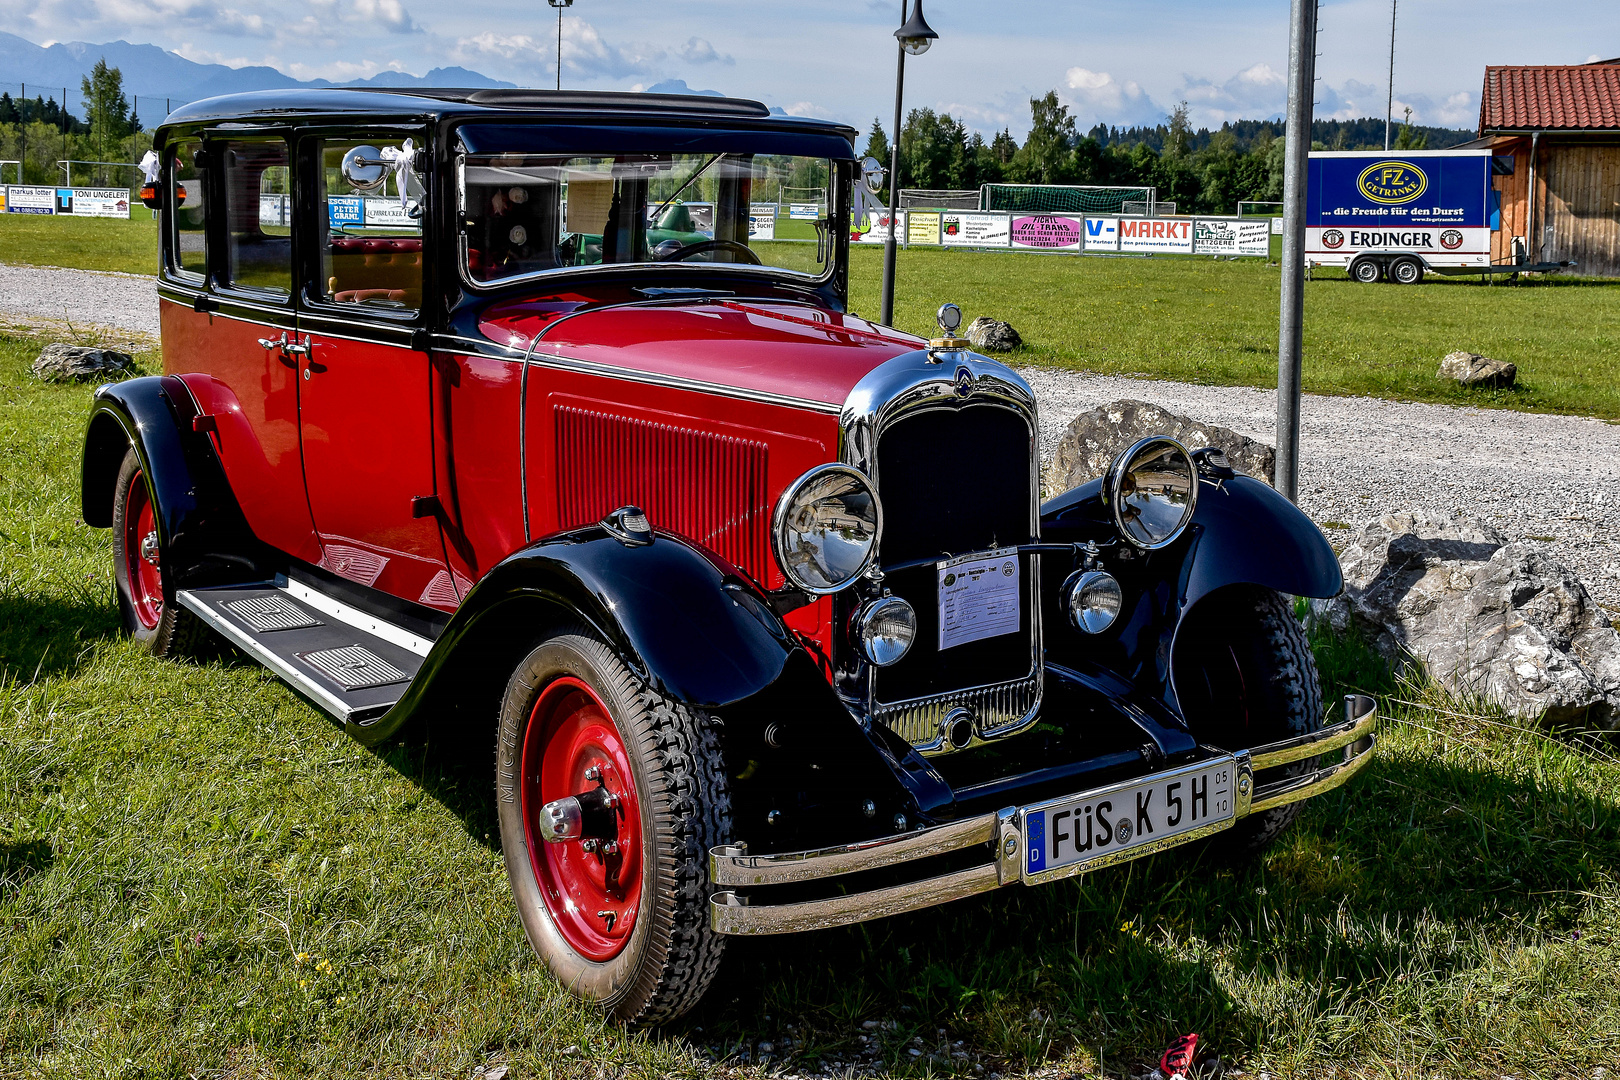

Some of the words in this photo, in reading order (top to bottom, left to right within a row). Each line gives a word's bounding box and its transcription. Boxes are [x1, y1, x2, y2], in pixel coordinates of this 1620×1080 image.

[1381, 168, 1405, 186] FZ
[35, 188, 51, 196] lotter
[74, 190, 91, 198] TONI
[93, 191, 128, 199] UNGELERT
[1365, 181, 1419, 197] GETRÄNKE
[334, 205, 360, 213] PETER
[334, 212, 360, 220] GRAML
[1333, 207, 1350, 216] die
[1351, 207, 1388, 216] Freude
[1390, 207, 1408, 216] für
[1410, 207, 1430, 216] den
[1432, 207, 1464, 216] Durst
[1033, 216, 1058, 224] FICHTL
[1121, 221, 1191, 239] MARKT
[1195, 239, 1235, 247] METZGEREI
[1349, 230, 1433, 248] ERDINGER
[500, 672, 535, 804] MICHELIN
[1215, 770, 1228, 785] 05
[1215, 799, 1228, 814] 10
[1052, 800, 1114, 860] FÜS
[1136, 788, 1154, 837] K
[1166, 781, 1183, 827] 5
[1191, 774, 1208, 821] H
[1031, 848, 1039, 863] D
[1078, 858, 1107, 872] Classic
[1110, 846, 1154, 864] Automobile
